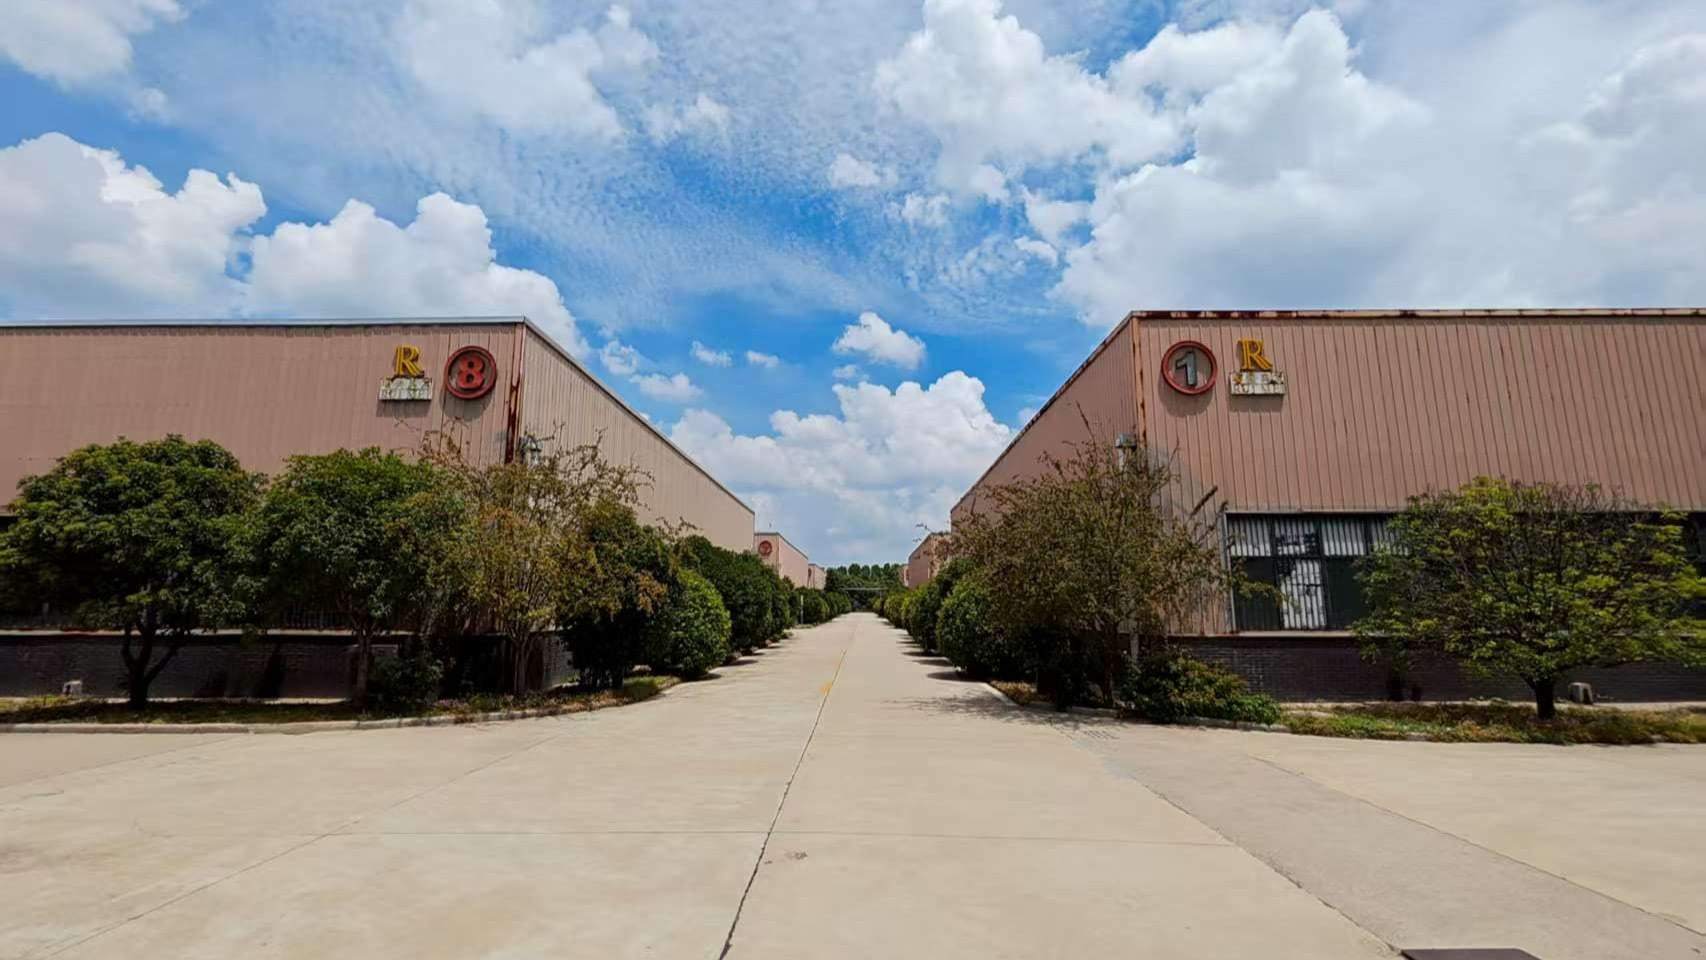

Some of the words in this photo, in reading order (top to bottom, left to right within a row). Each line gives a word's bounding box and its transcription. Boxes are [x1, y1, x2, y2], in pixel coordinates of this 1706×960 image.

[395, 345, 423, 376] R
[1175, 351, 1198, 386] 1
[1239, 338, 1273, 370] R
[457, 356, 485, 389] 8
